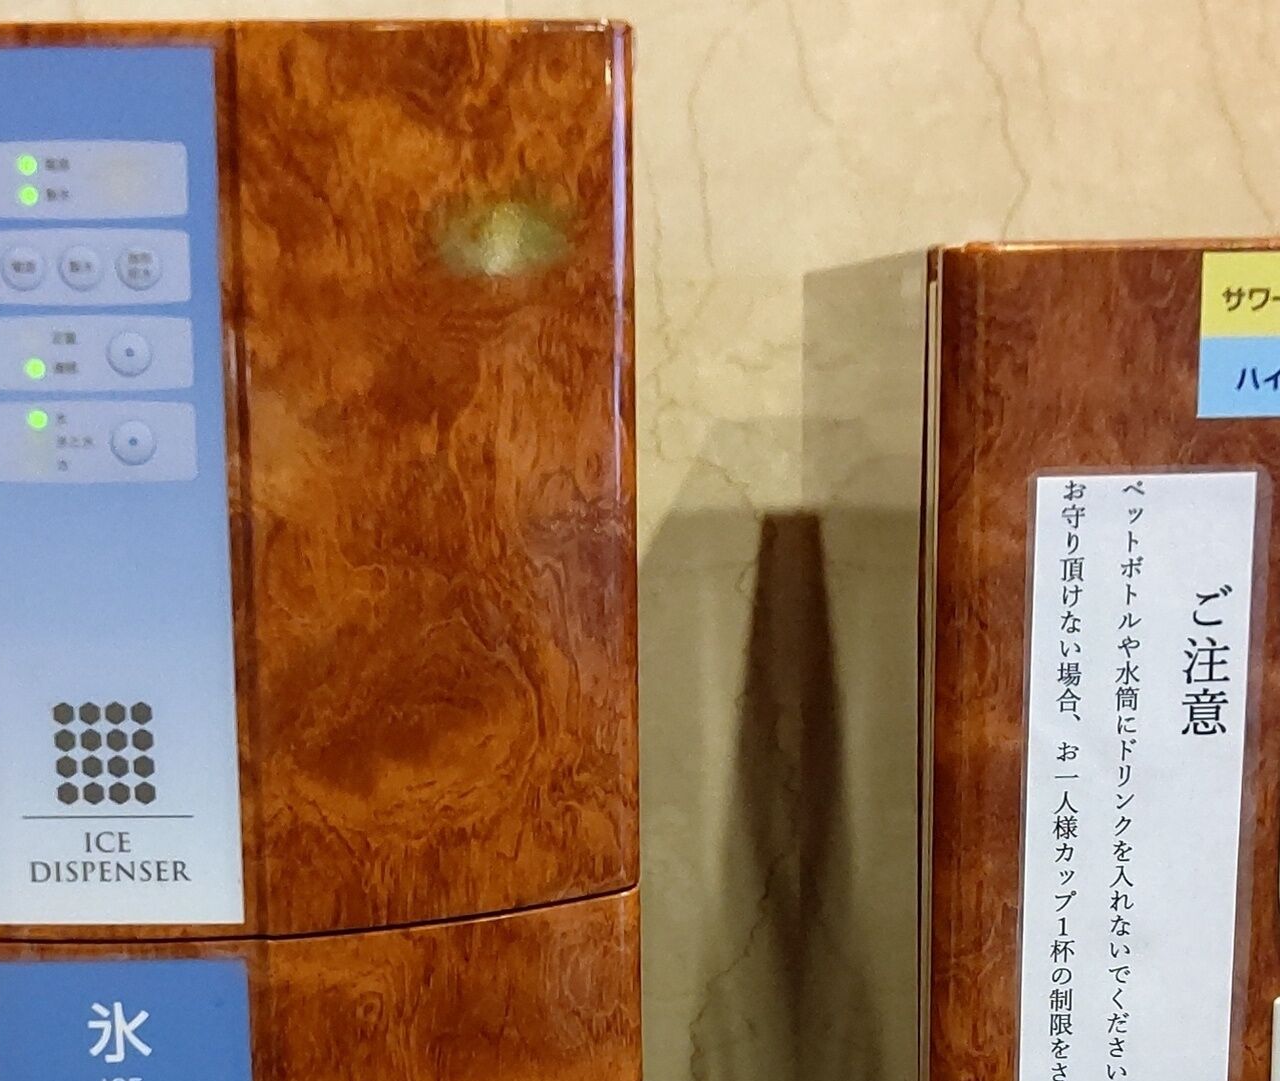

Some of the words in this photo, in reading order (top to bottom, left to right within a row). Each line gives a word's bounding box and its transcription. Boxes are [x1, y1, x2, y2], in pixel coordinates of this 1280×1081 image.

[1181, 584, 1233, 736] ご注意
[84, 831, 132, 854] ICE
[30, 859, 192, 884] DISPENSER
[87, 1001, 153, 1064] 氷
